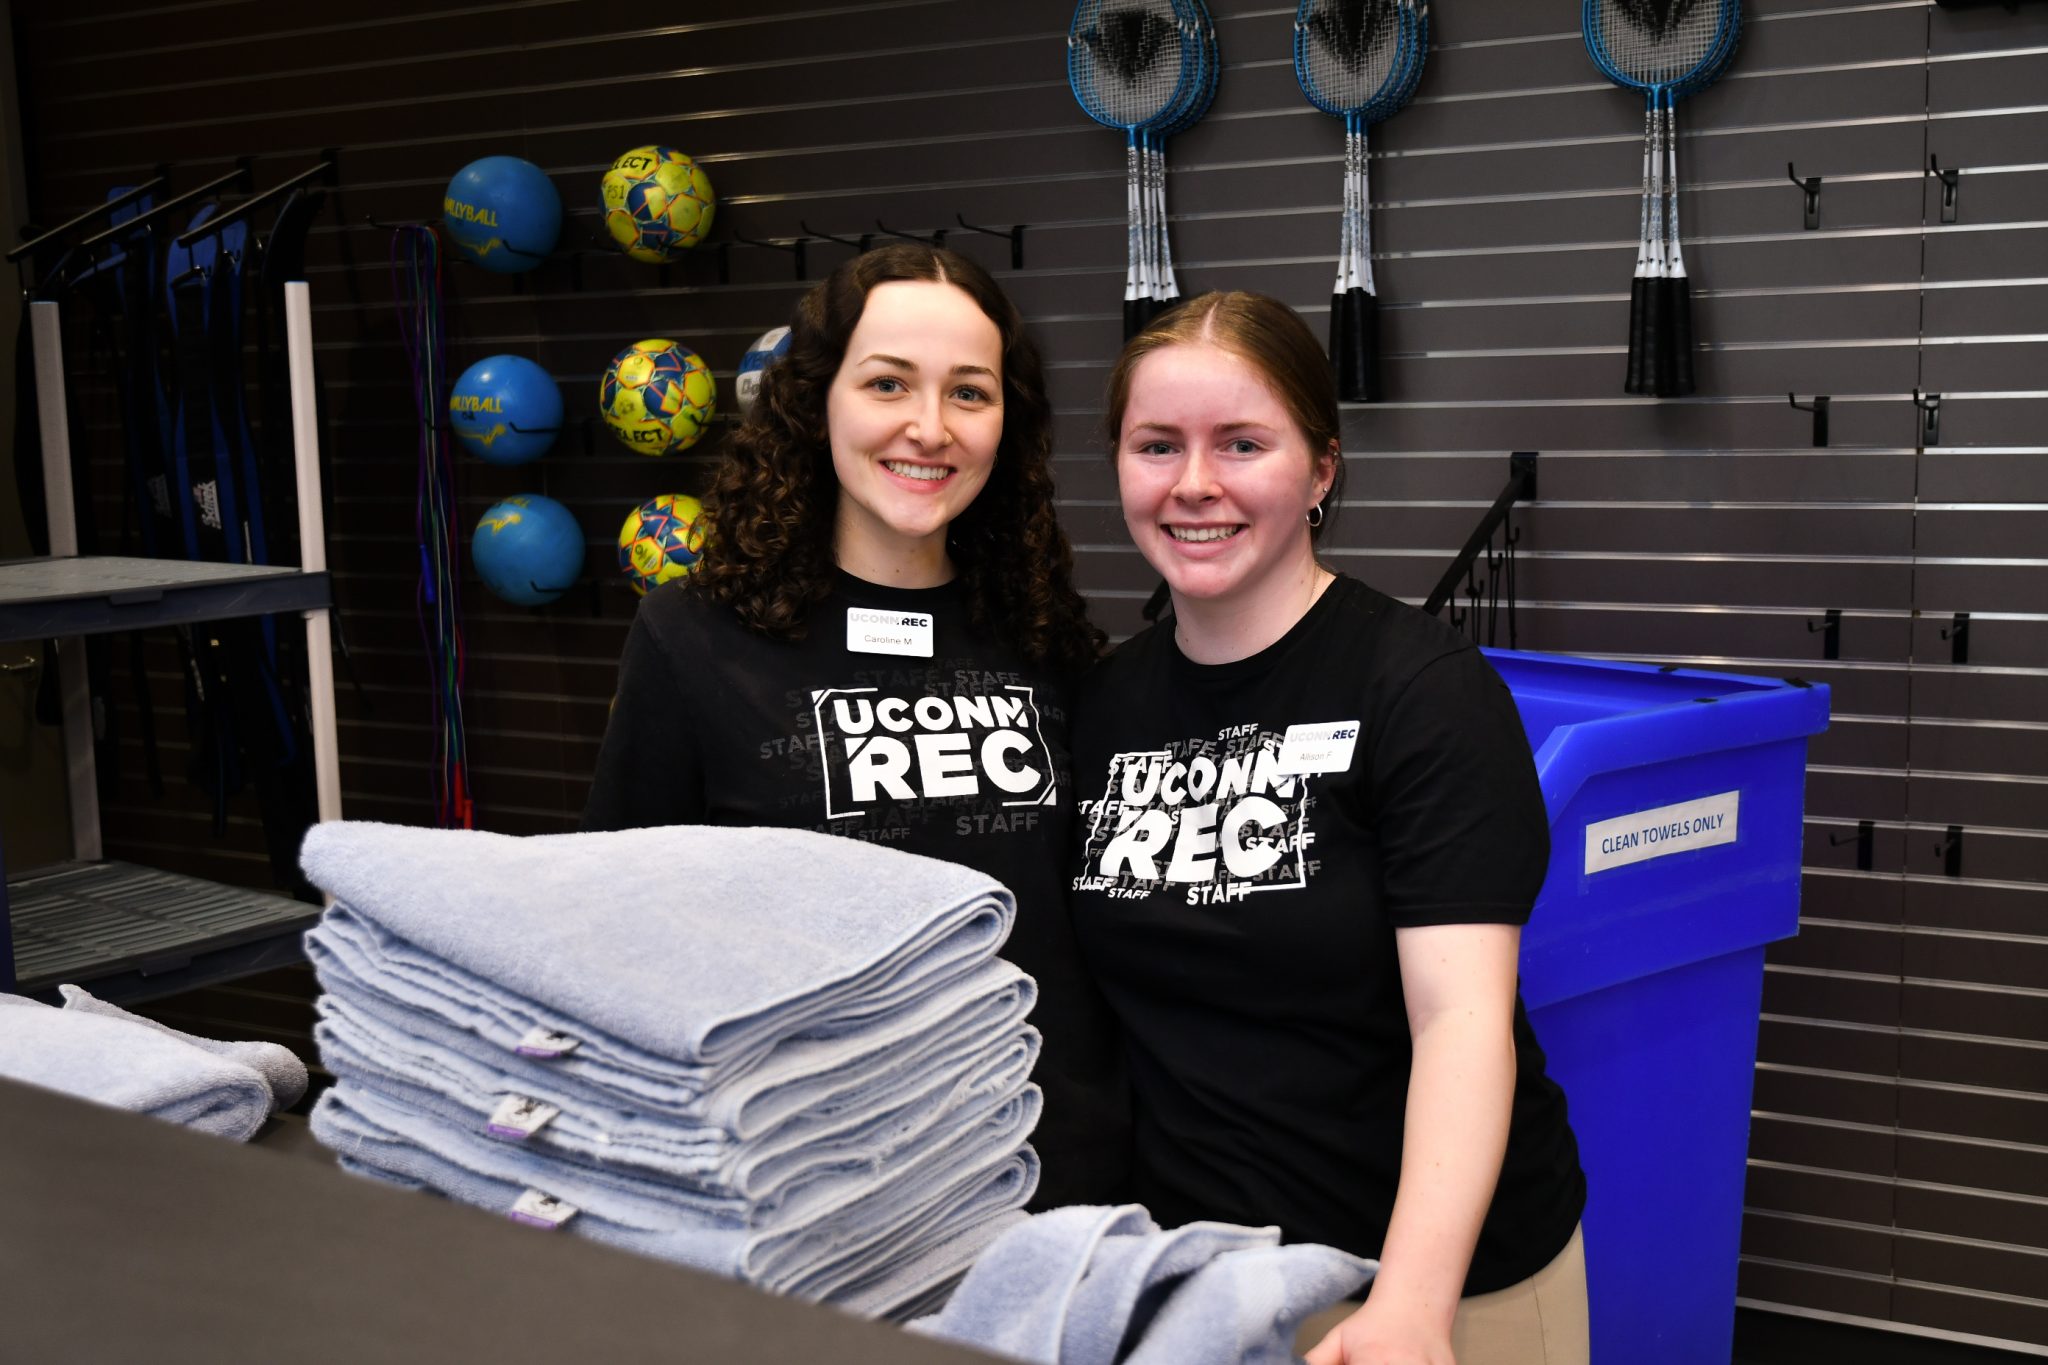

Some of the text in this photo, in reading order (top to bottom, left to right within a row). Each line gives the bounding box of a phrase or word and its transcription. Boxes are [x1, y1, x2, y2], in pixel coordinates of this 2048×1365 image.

[612, 156, 653, 170] LECT
[444, 196, 498, 228] ALLYBALL
[449, 395, 503, 413] ALLYBALL
[620, 429, 663, 443] LECT
[901, 617, 928, 627] REC
[864, 634, 913, 645] Caroline M
[954, 670, 1021, 686] STAFF
[833, 696, 1029, 735] UCONN
[1218, 723, 1259, 741] STAFF
[1331, 729, 1356, 740] REC
[760, 732, 835, 760] STAFF
[845, 729, 1042, 802] REC
[956, 811, 1039, 836] STAFF
[858, 827, 910, 841] STAFF
[1100, 796, 1289, 884] REC
[1245, 832, 1316, 853] STAFF
[1602, 813, 1724, 854] CLEAN TOWELS ONLY
[1073, 877, 1113, 891] STAFF
[1108, 888, 1151, 900] STAFF
[1186, 882, 1253, 906] STAFF
